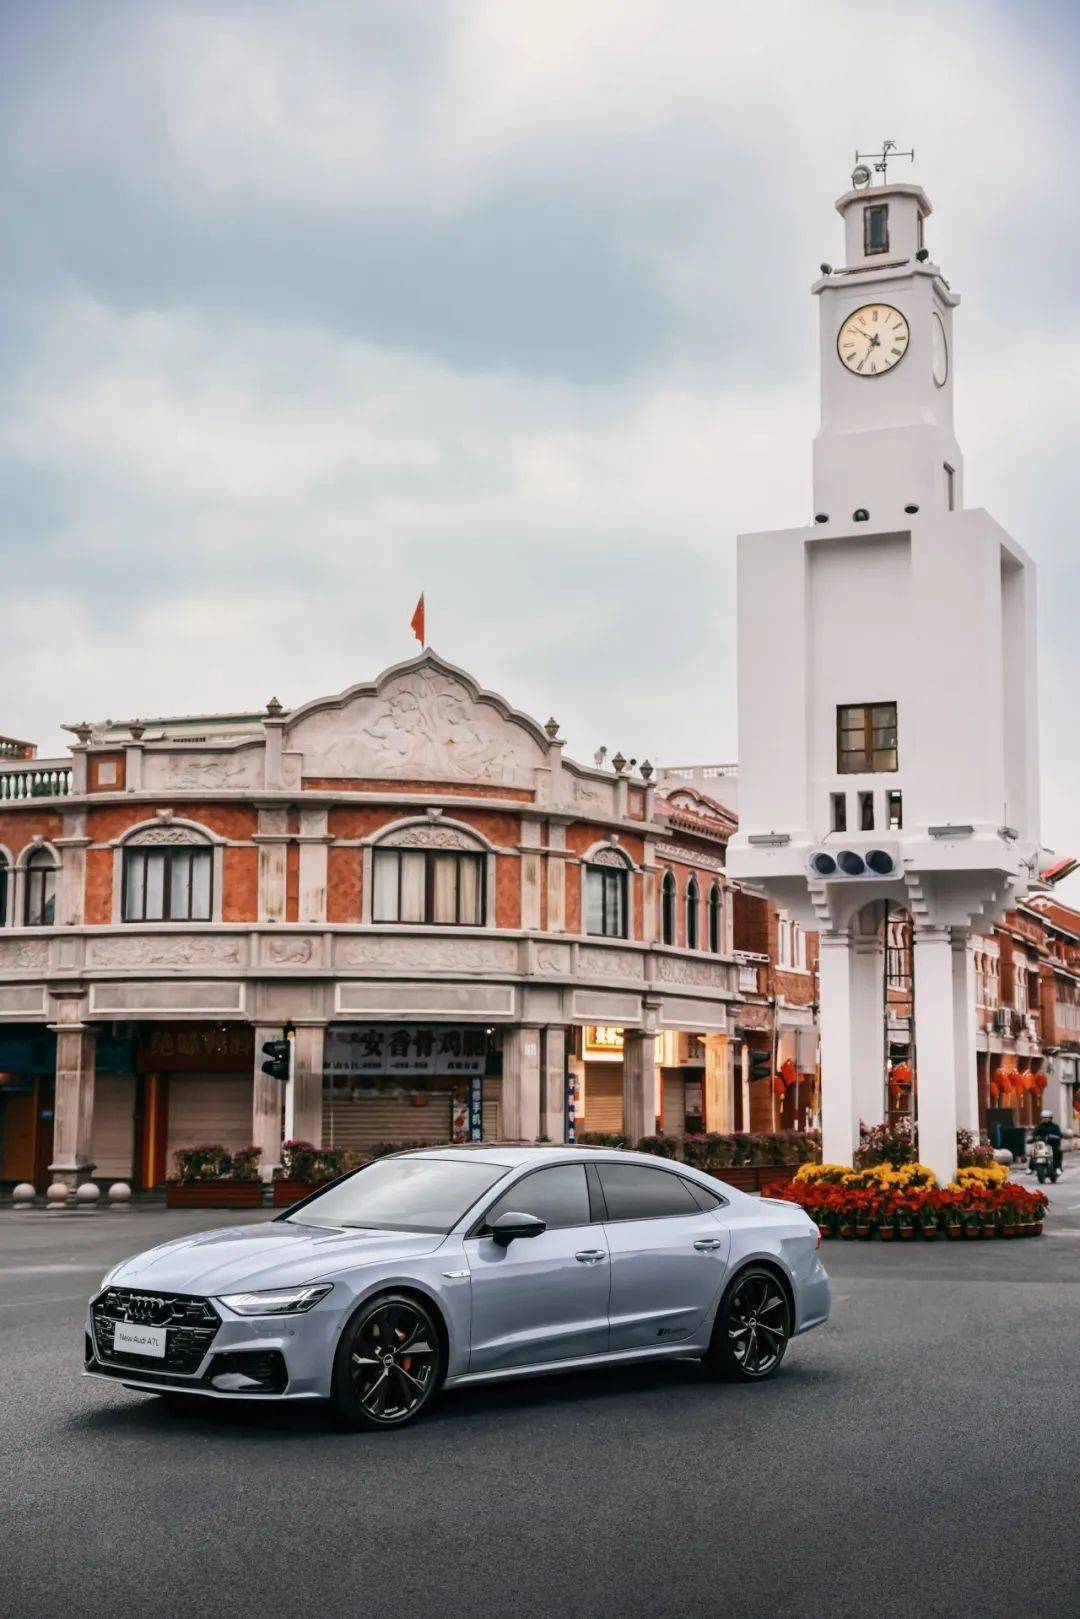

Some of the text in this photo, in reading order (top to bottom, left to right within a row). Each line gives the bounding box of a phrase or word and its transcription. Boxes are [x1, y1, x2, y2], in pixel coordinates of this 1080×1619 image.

[120, 1333, 159, 1347] New Audi A7L
